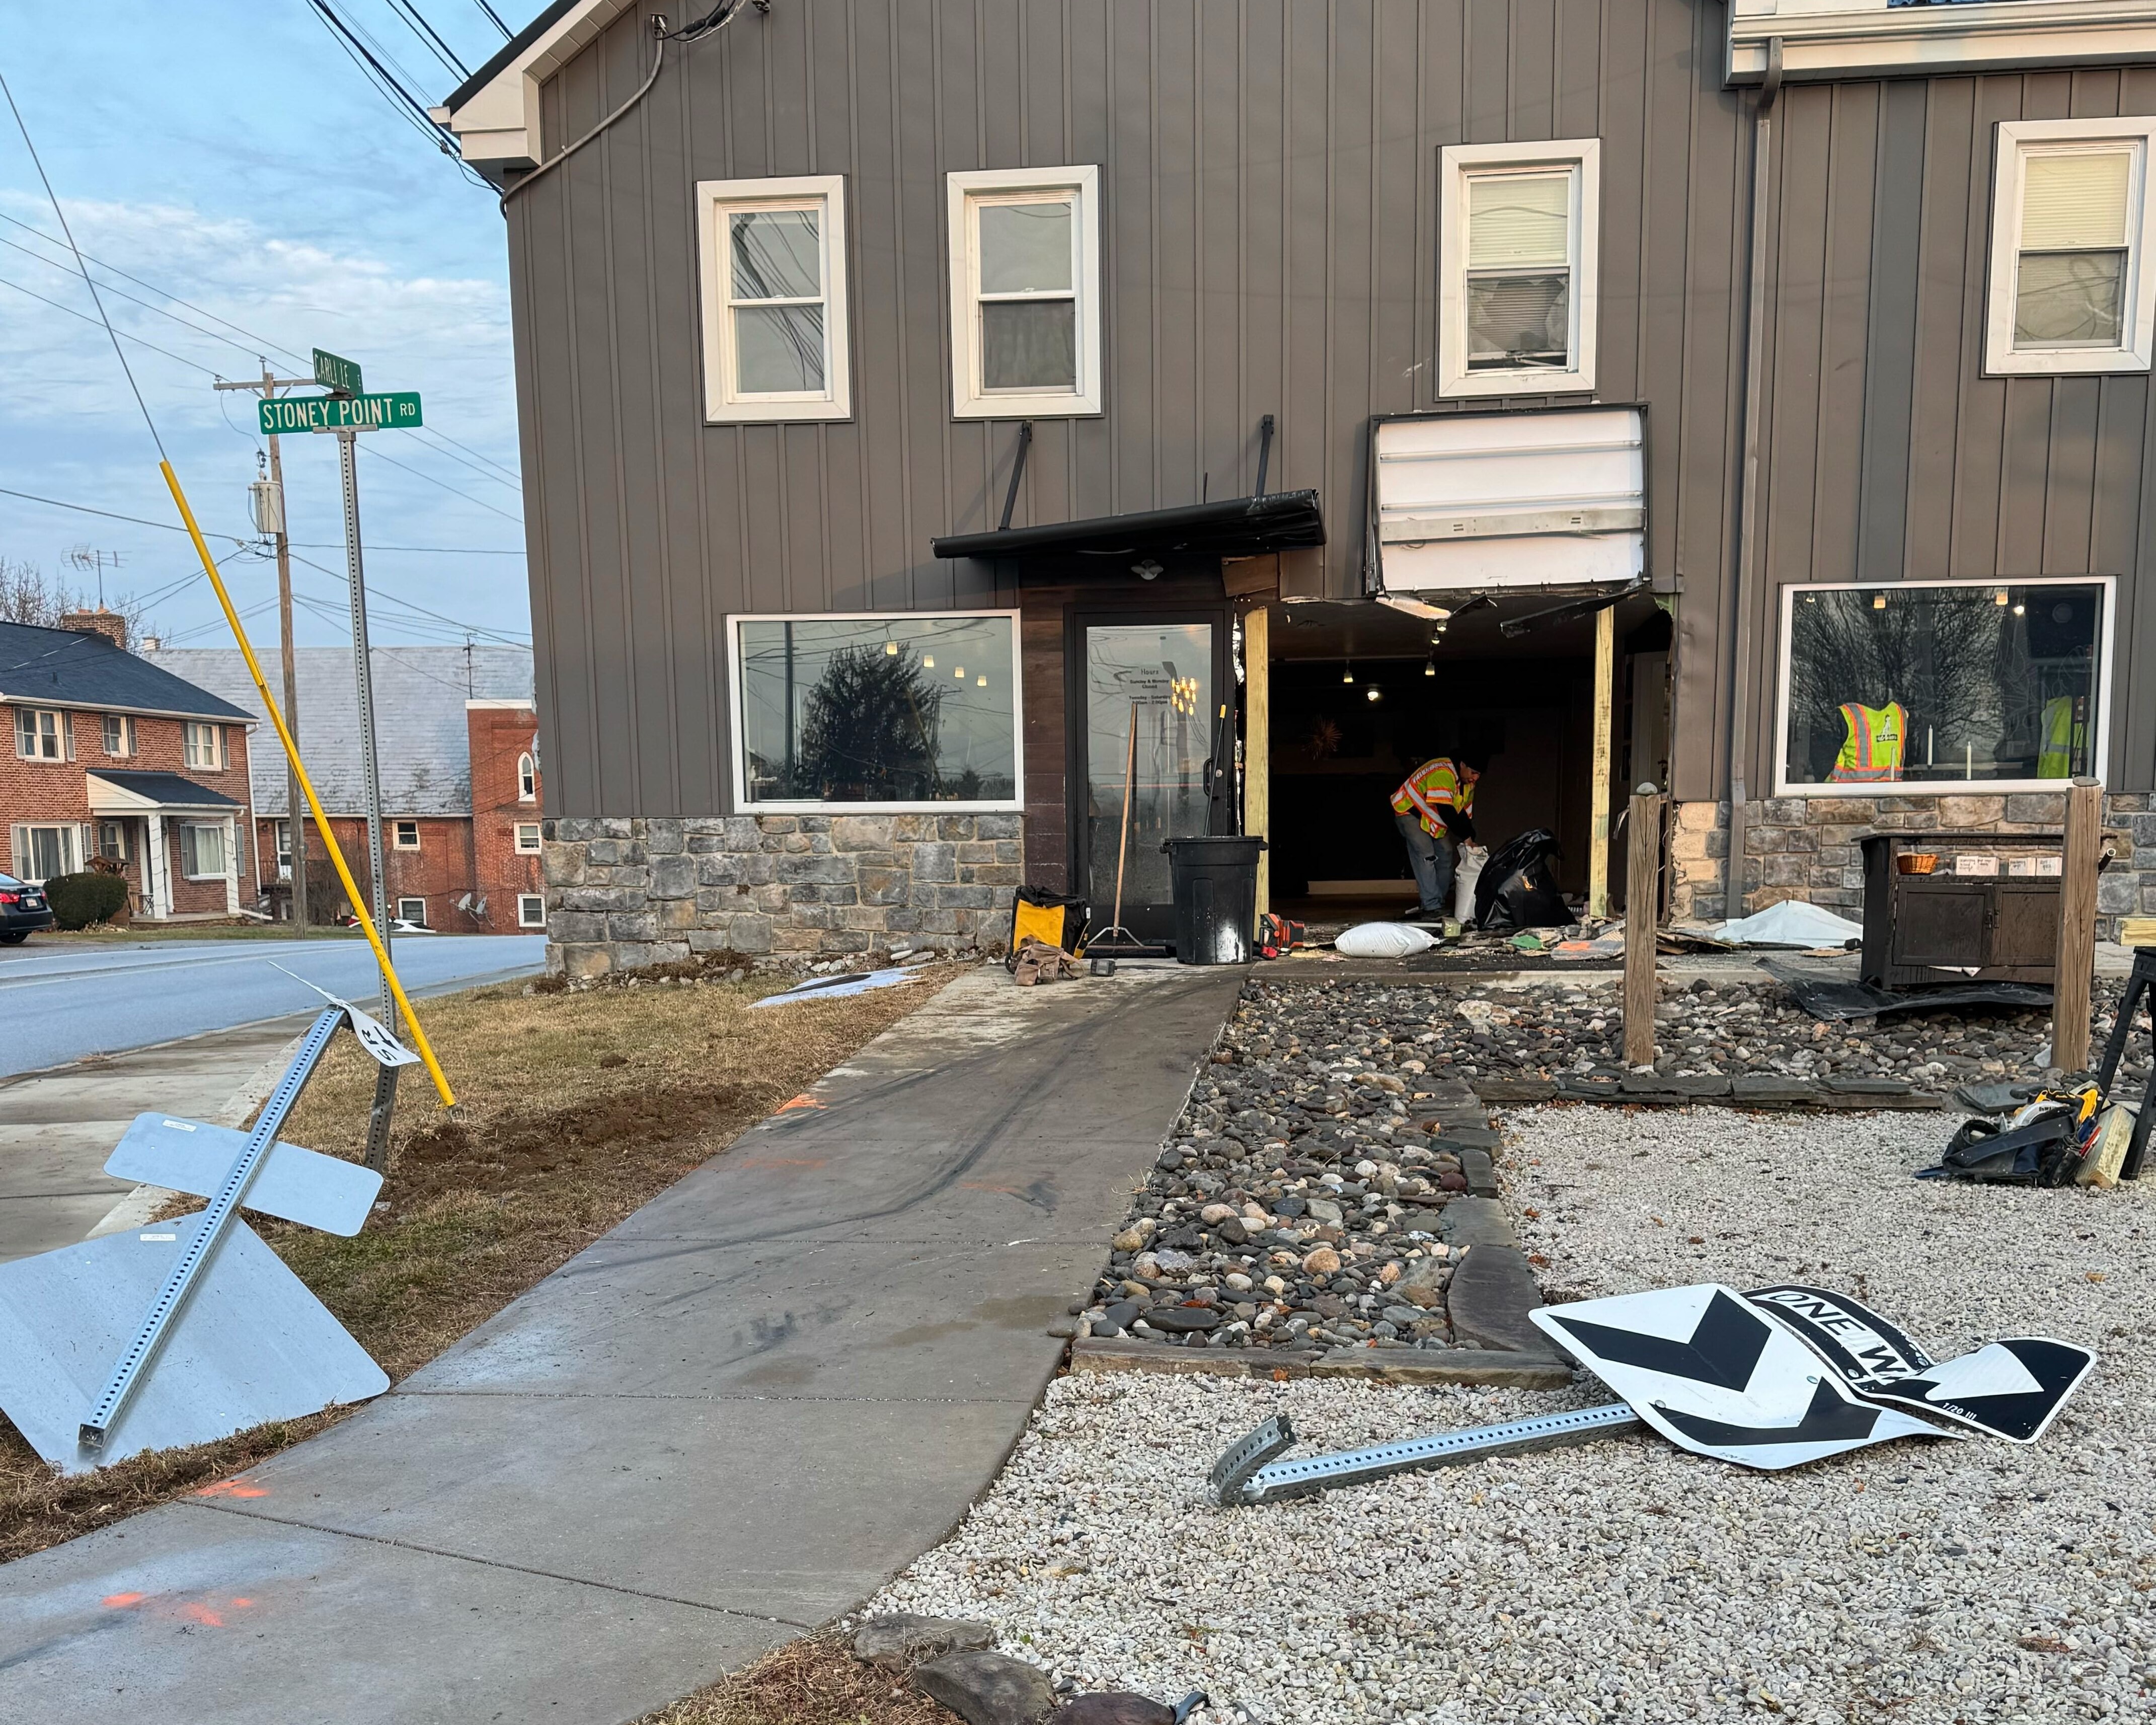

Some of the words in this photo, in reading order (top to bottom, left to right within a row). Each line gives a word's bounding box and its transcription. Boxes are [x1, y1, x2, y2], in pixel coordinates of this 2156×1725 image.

[314, 353, 350, 389] CARLILE
[263, 401, 330, 429] STONEY
[339, 398, 393, 425] POINT
[400, 403, 415, 416] RD
[1768, 1294, 1866, 1335] ONE
[1943, 1402, 1964, 1414] 1/20
